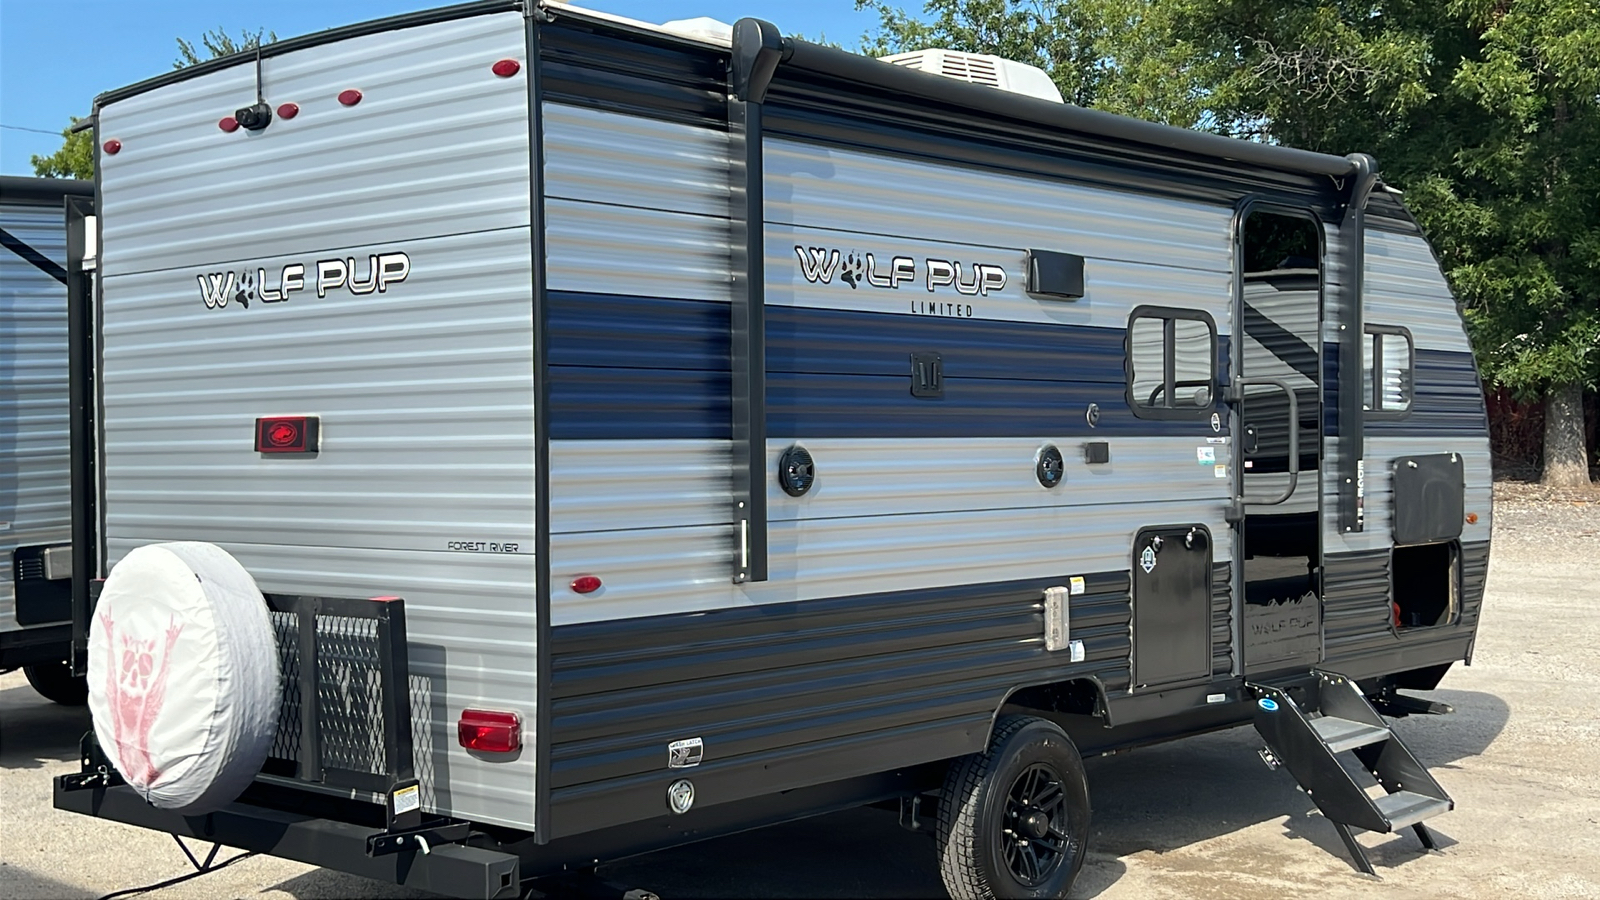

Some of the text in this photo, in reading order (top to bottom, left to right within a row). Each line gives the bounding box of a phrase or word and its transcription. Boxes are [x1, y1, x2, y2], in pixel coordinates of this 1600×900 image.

[316, 250, 411, 300] PUP
[925, 257, 1008, 297] PUP
[910, 300, 973, 317] LIMITED
[448, 541, 519, 552] FOREST RIVER
